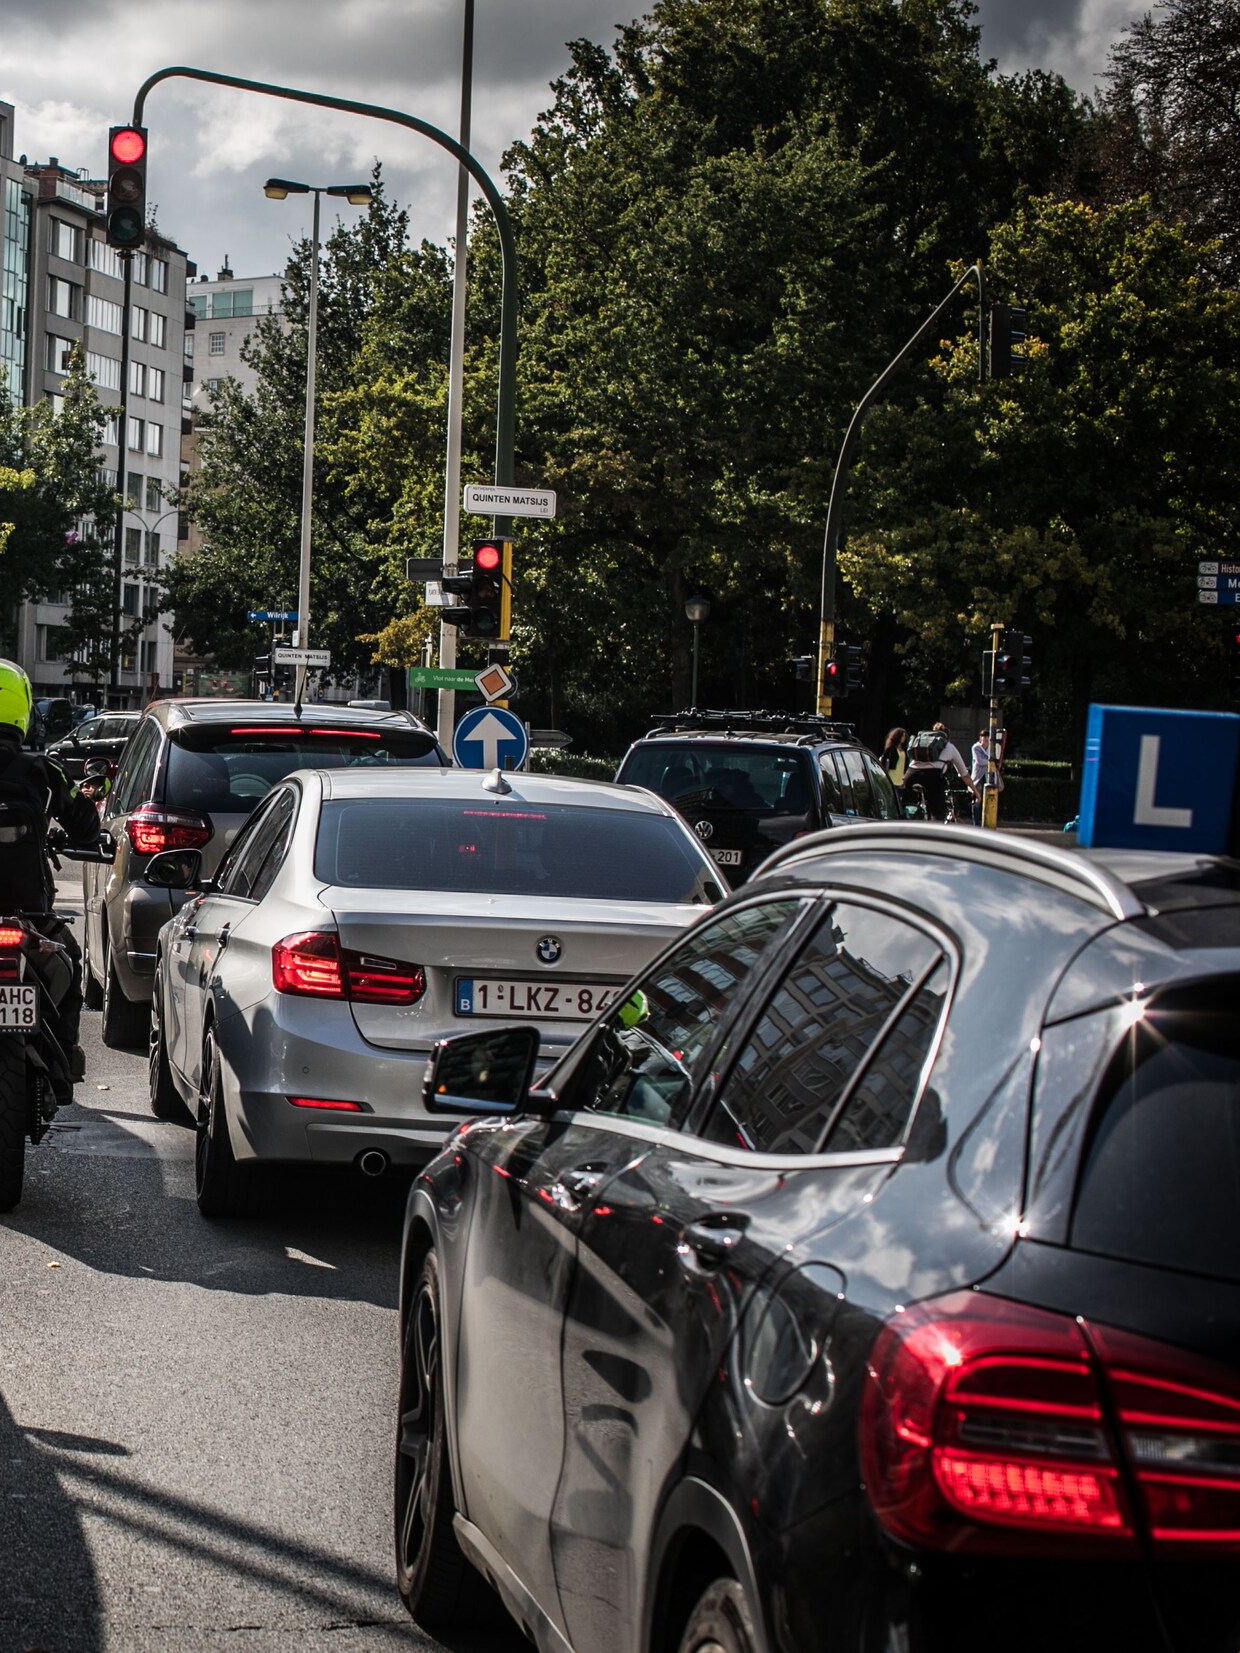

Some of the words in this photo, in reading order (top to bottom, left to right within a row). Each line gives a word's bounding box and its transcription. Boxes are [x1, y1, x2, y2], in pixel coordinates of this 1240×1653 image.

[472, 493, 510, 504] QUINTEN
[512, 496, 549, 507] MATSIJS
[266, 611, 288, 619] Wilrijk
[1133, 734, 1193, 828] L
[0, 1007, 34, 1024] 118
